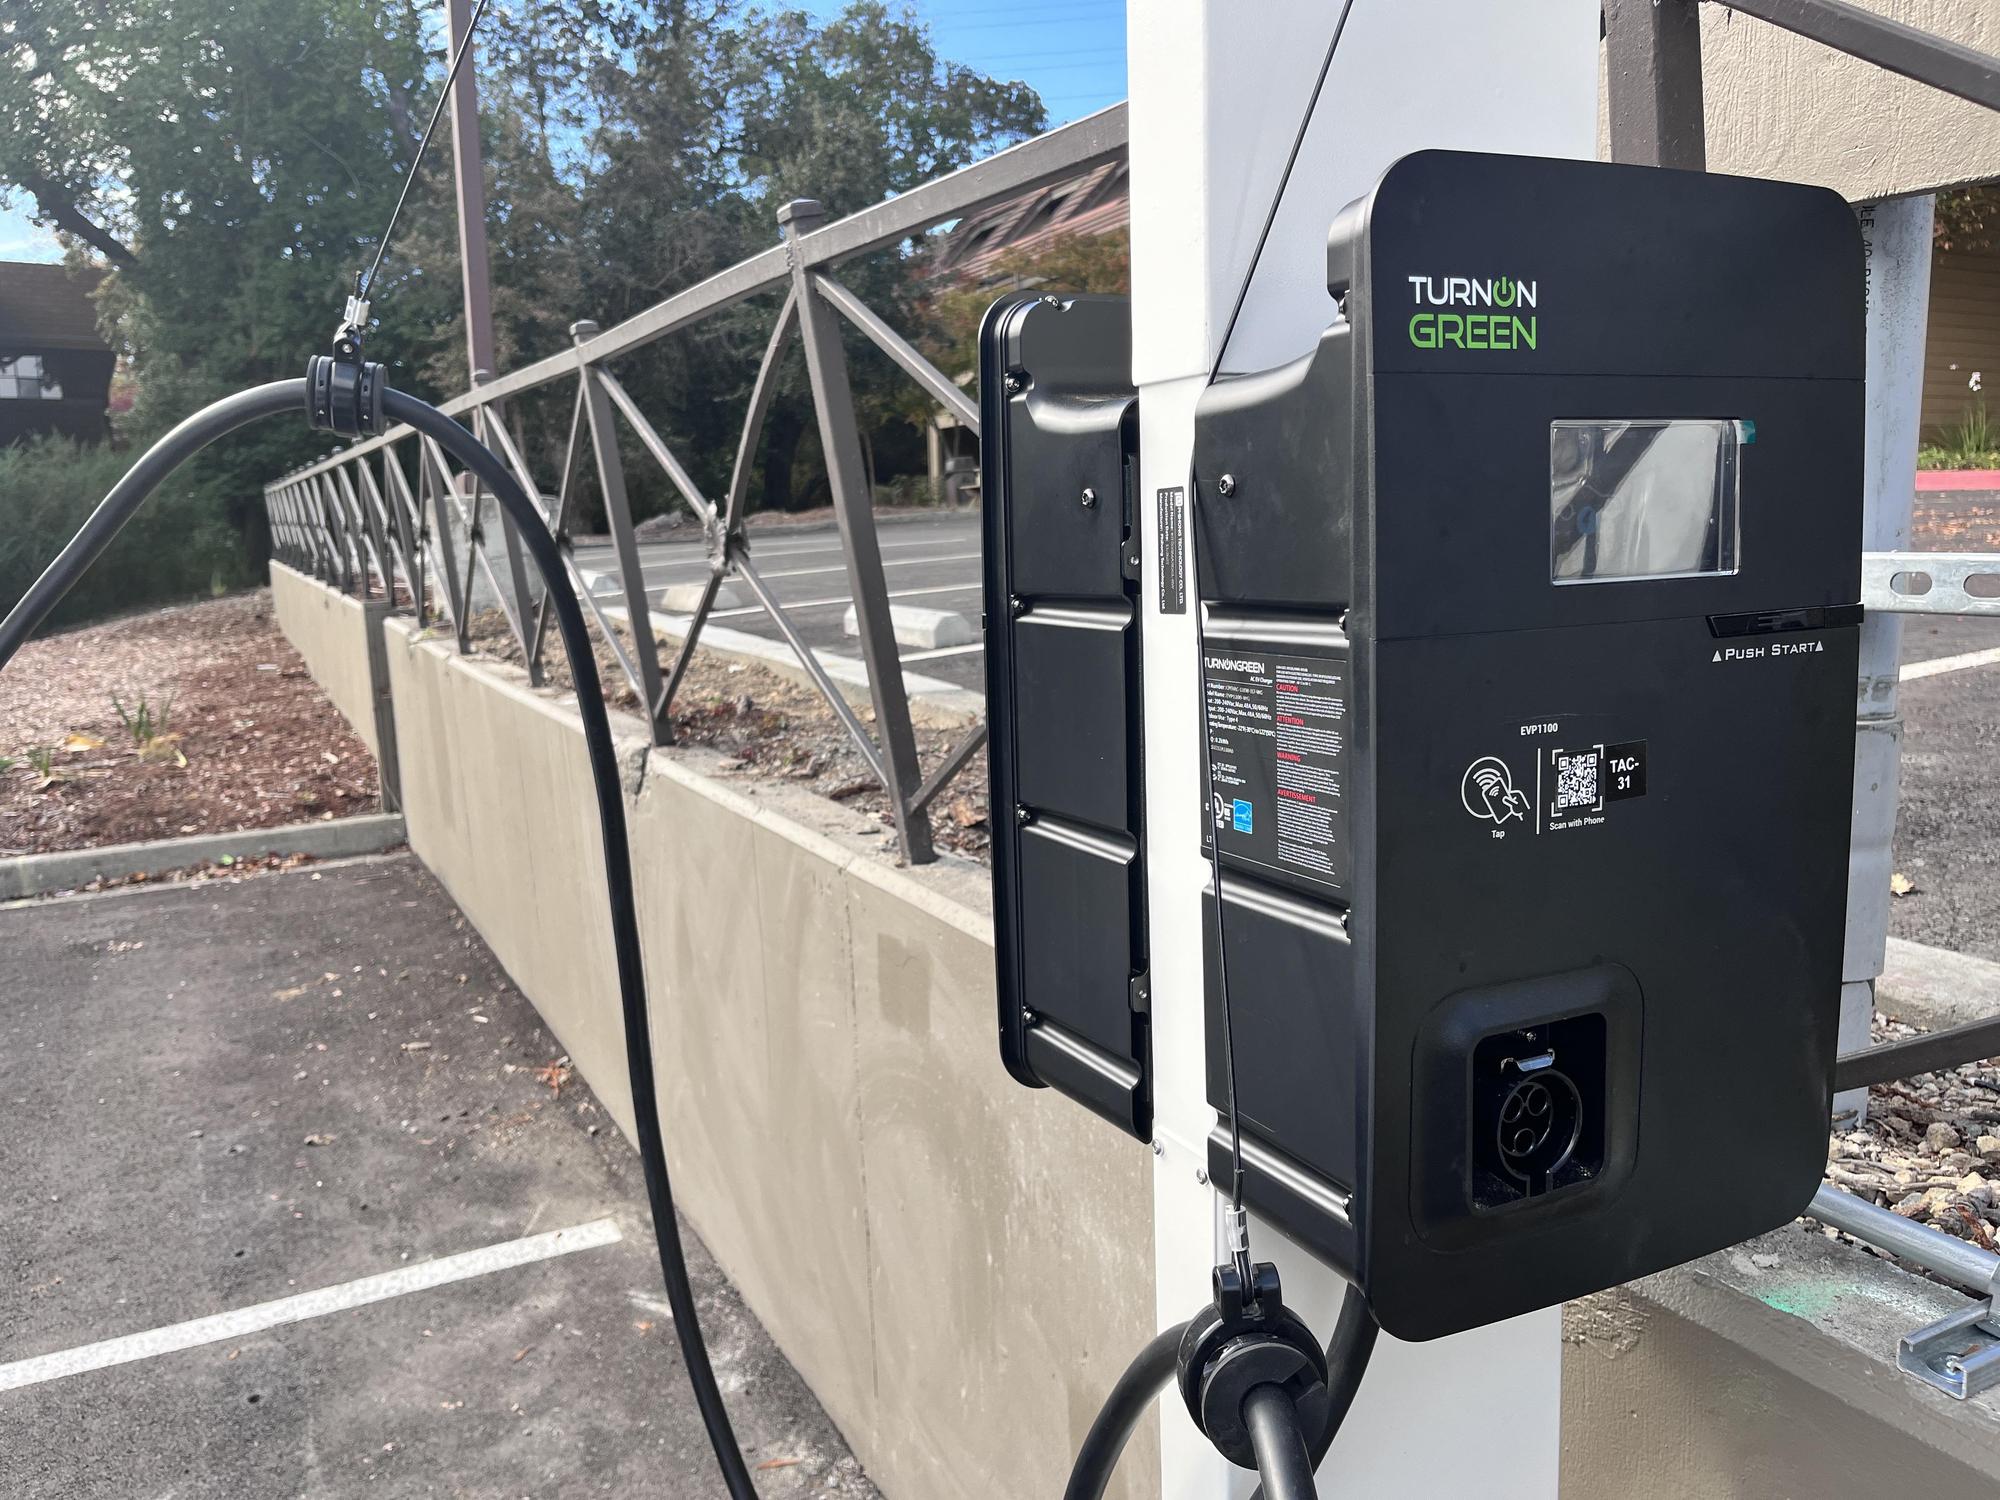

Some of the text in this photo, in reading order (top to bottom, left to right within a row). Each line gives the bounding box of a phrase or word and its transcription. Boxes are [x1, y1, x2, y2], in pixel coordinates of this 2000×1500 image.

[1408, 276, 1537, 308] TURNON
[1409, 313, 1537, 350] GREEN
[1276, 683, 1298, 692] CAUTION
[1276, 716, 1304, 725] ATTENTION
[1520, 723, 1558, 735] EVP1100
[1276, 752, 1301, 762] WARNING
[1610, 757, 1639, 773] TAC-
[1618, 775, 1630, 790] 31
[1277, 788, 1316, 802] AVERTISSEMENT
[1549, 816, 1605, 830] Scan with Phone
[1491, 830, 1505, 839] Tap
